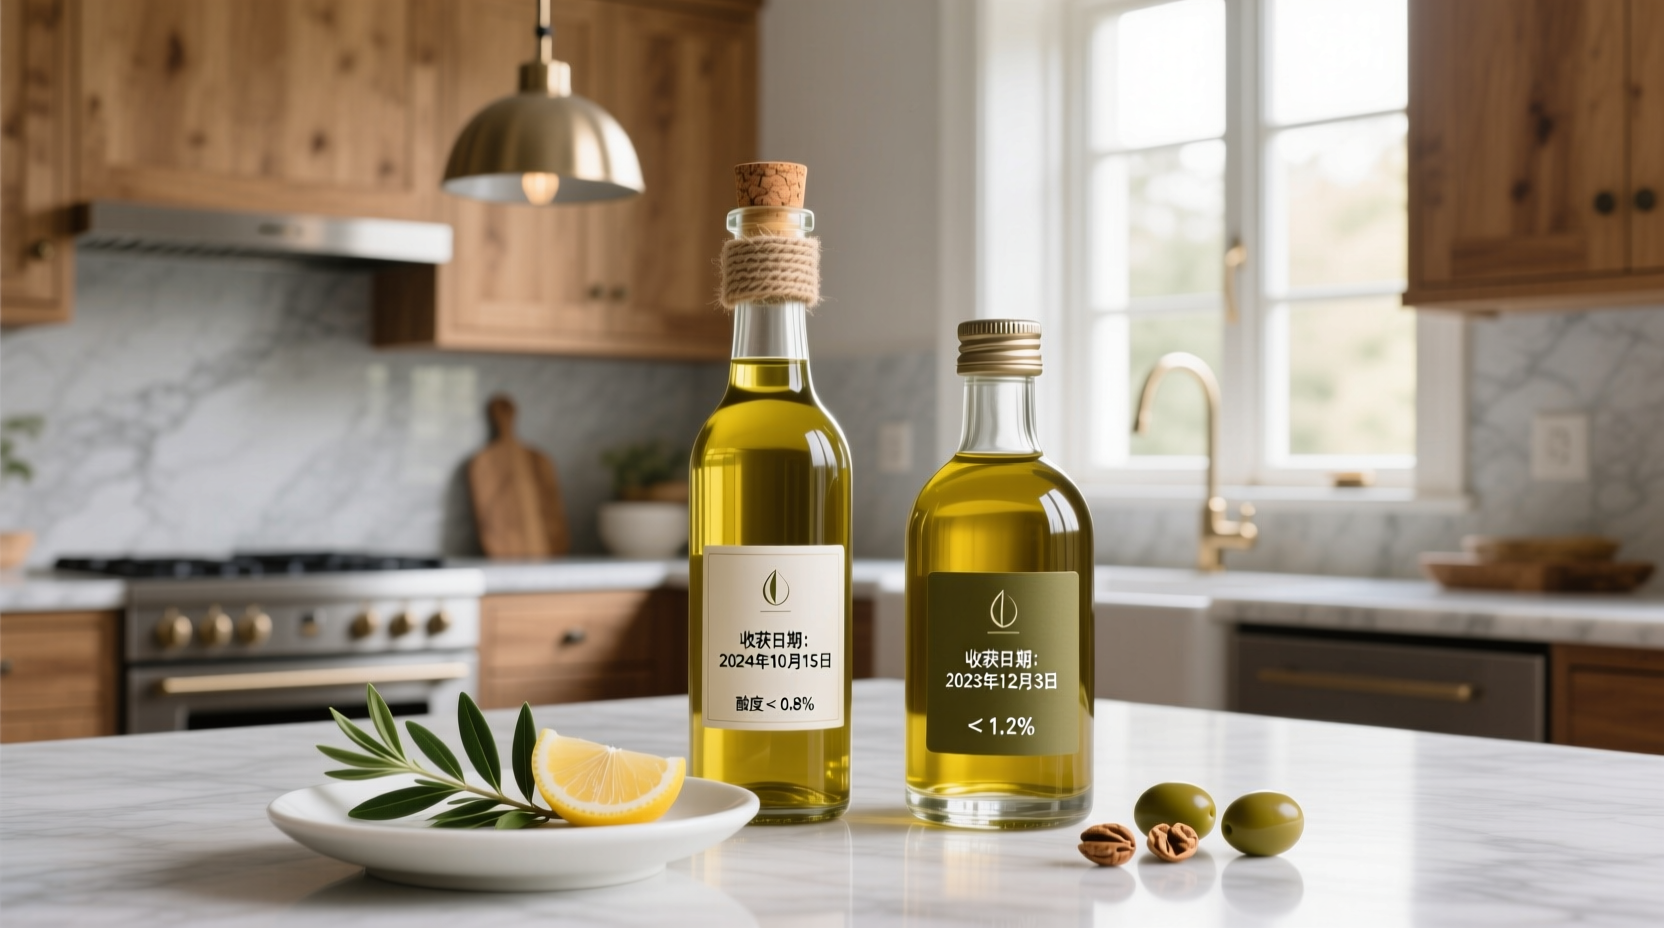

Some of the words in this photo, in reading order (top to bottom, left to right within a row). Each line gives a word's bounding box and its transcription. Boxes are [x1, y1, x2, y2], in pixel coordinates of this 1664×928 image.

[719, 653, 831, 670] 2024年10月15日
[945, 672, 1057, 690] 2023年12月3日
[989, 717, 1035, 735] 1.2%
